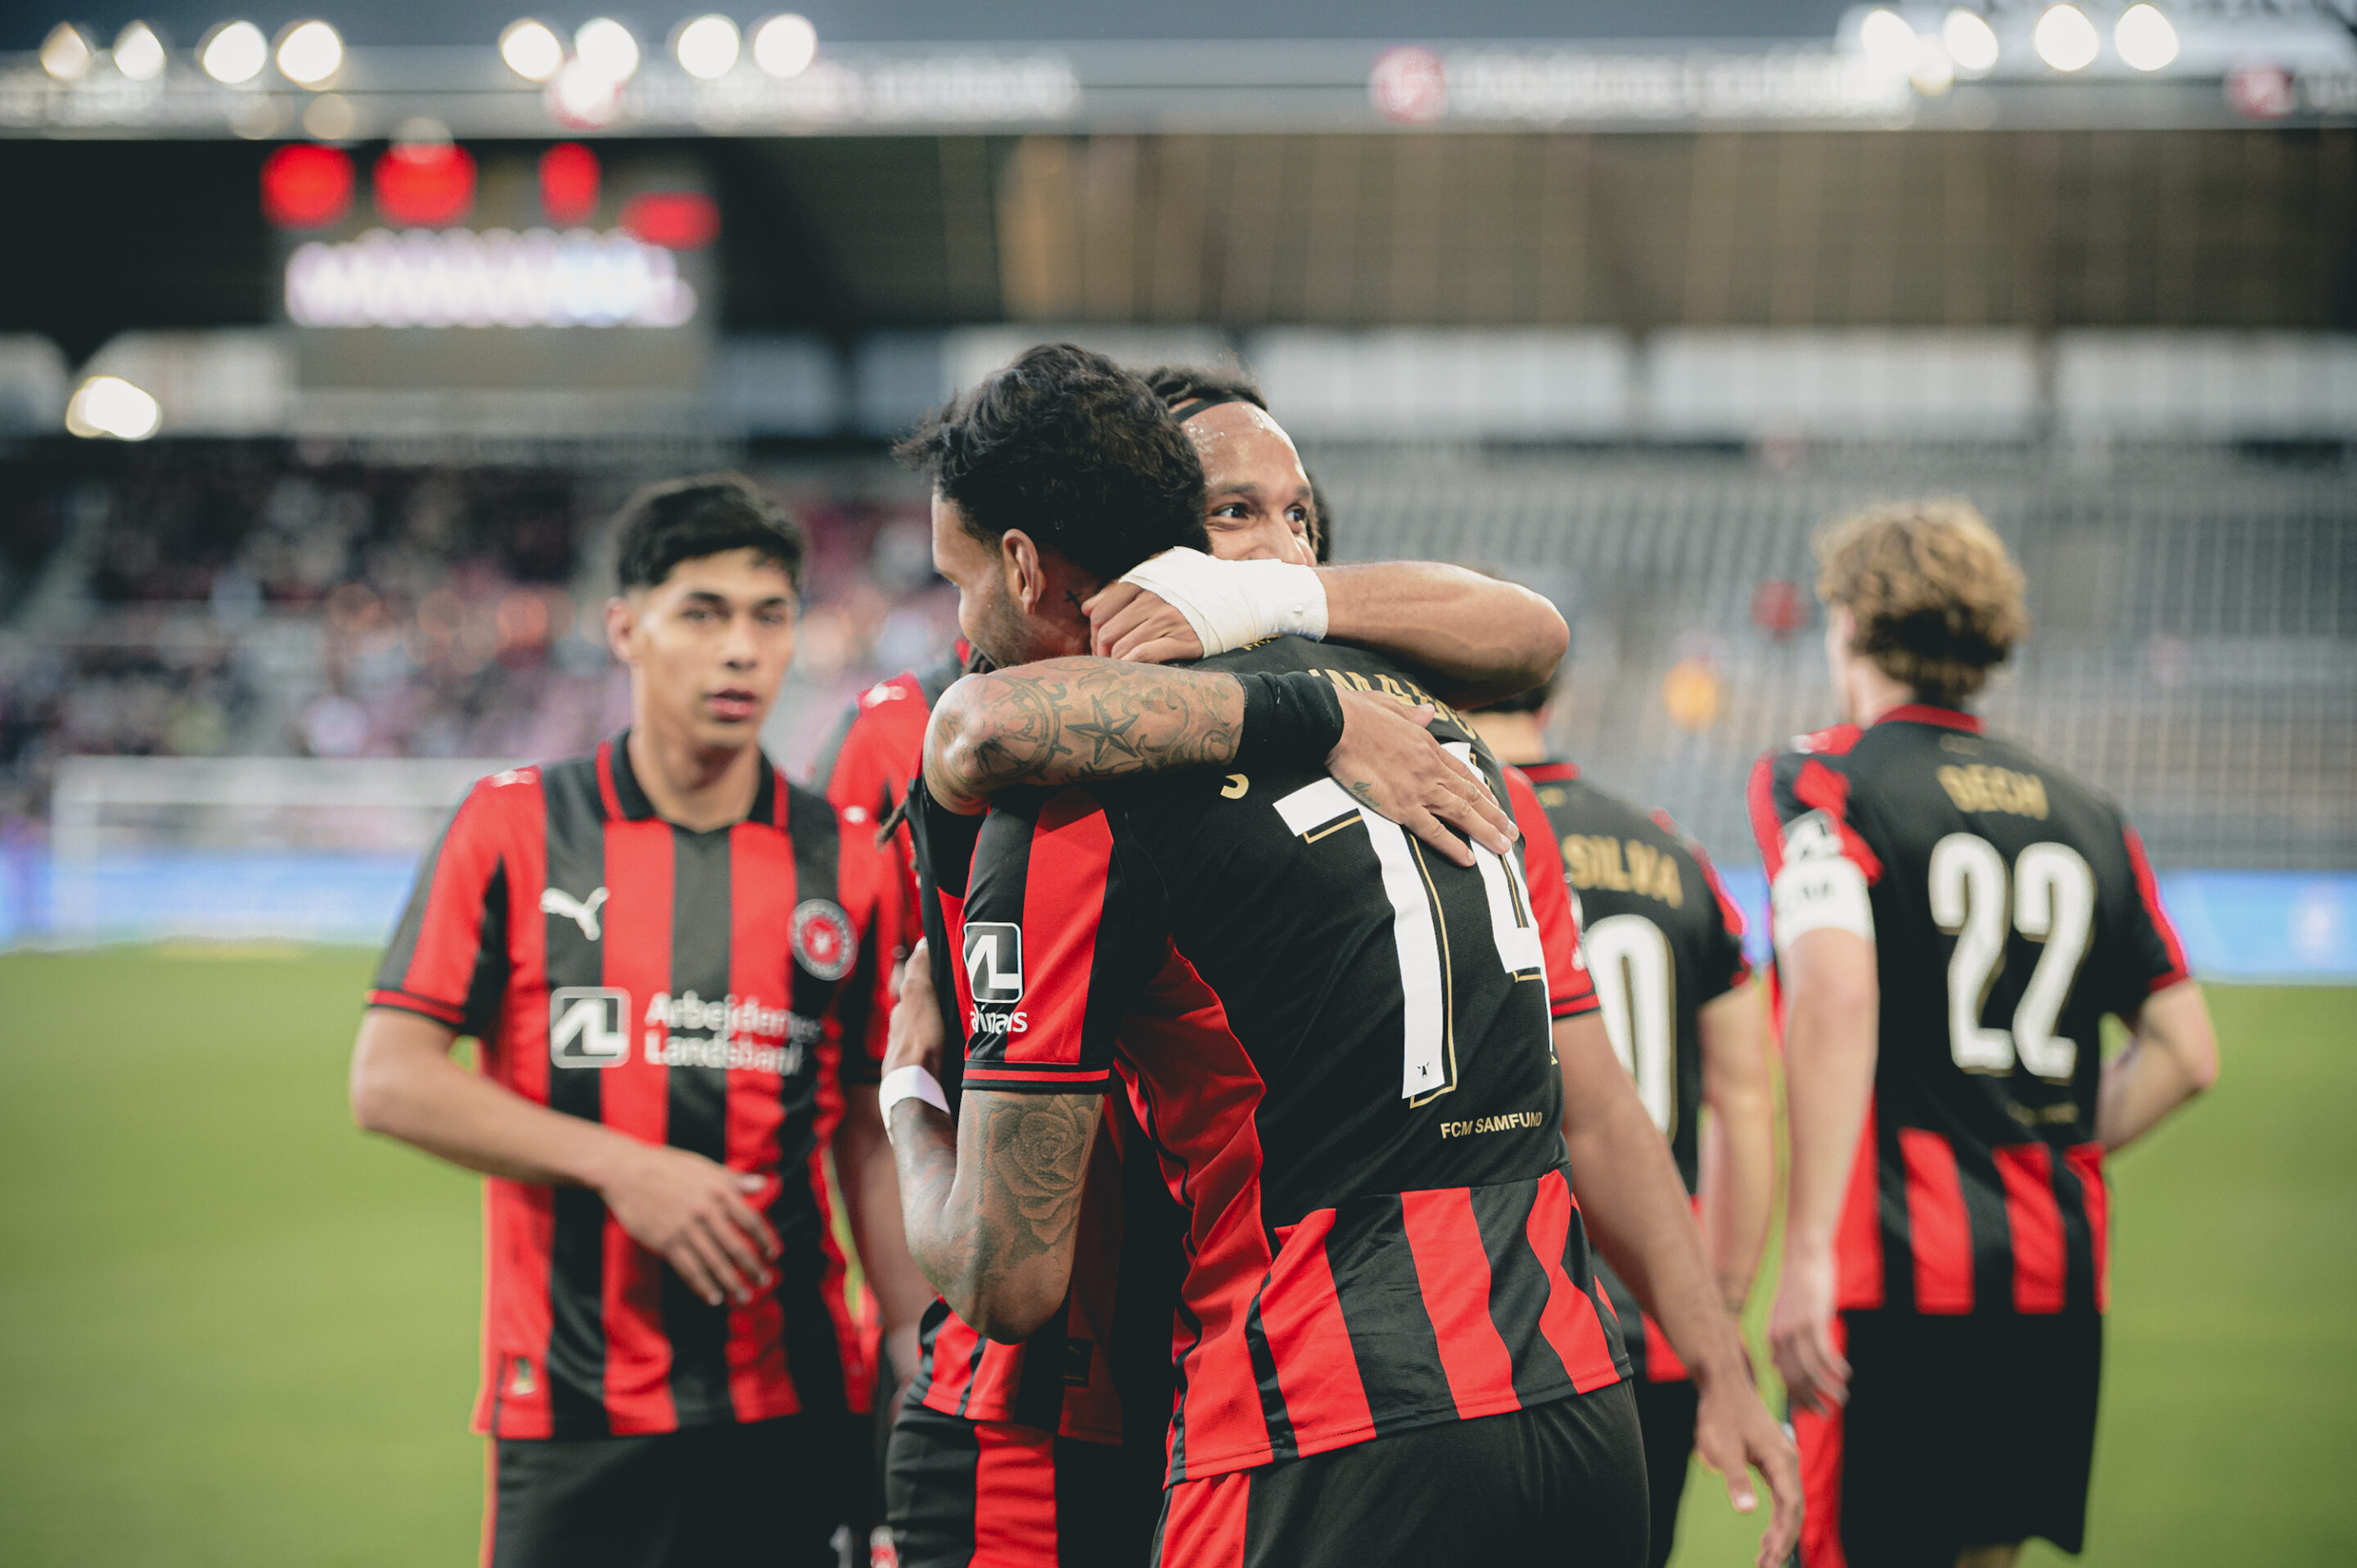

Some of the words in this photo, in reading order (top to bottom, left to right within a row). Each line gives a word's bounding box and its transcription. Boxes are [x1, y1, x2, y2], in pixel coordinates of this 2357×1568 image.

[1562, 834, 1683, 909] SILVA
[1928, 832, 2094, 1082] 22
[1440, 1120, 1473, 1139] FCM
[1475, 1111, 1543, 1133] SAMFUND
